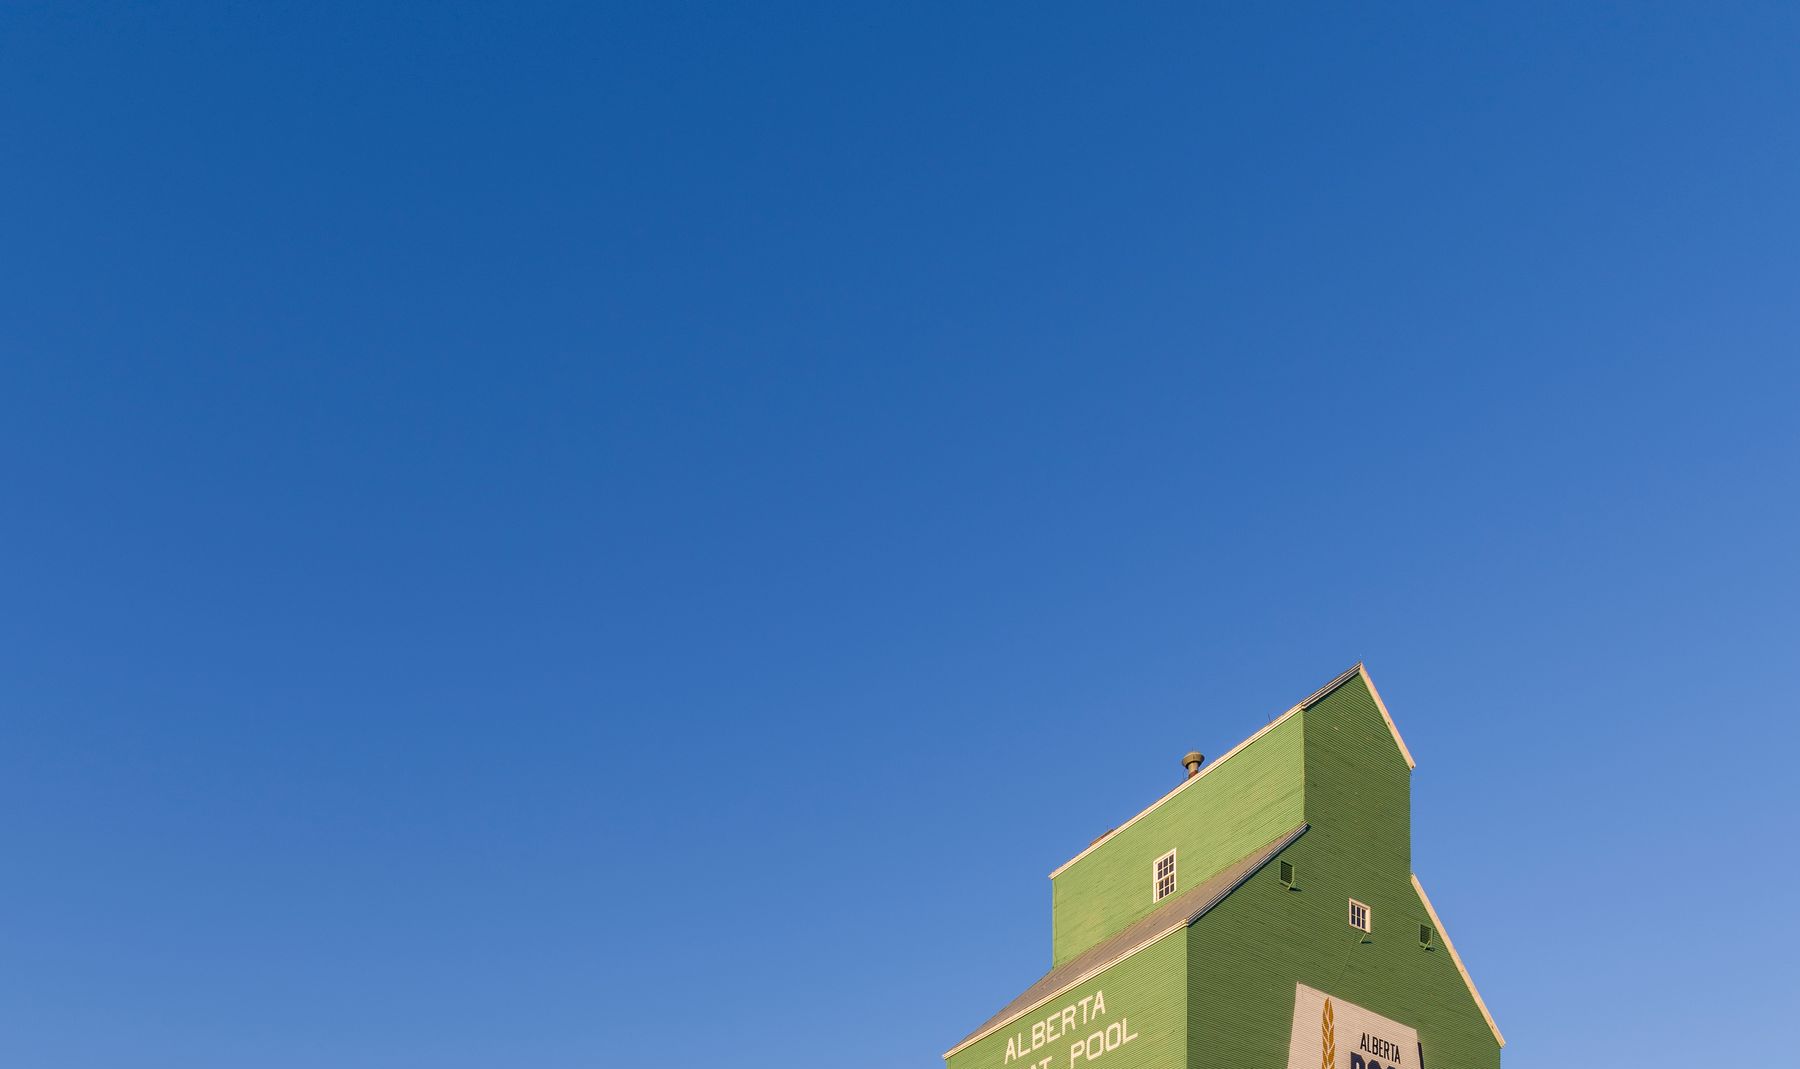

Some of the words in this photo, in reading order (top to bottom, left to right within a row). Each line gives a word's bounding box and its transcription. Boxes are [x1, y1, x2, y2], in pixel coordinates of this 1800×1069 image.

[1004, 990, 1106, 1065] ALBERTA
[1070, 1018, 1138, 1069] POOL
[1359, 1032, 1401, 1064] ALBERTA
